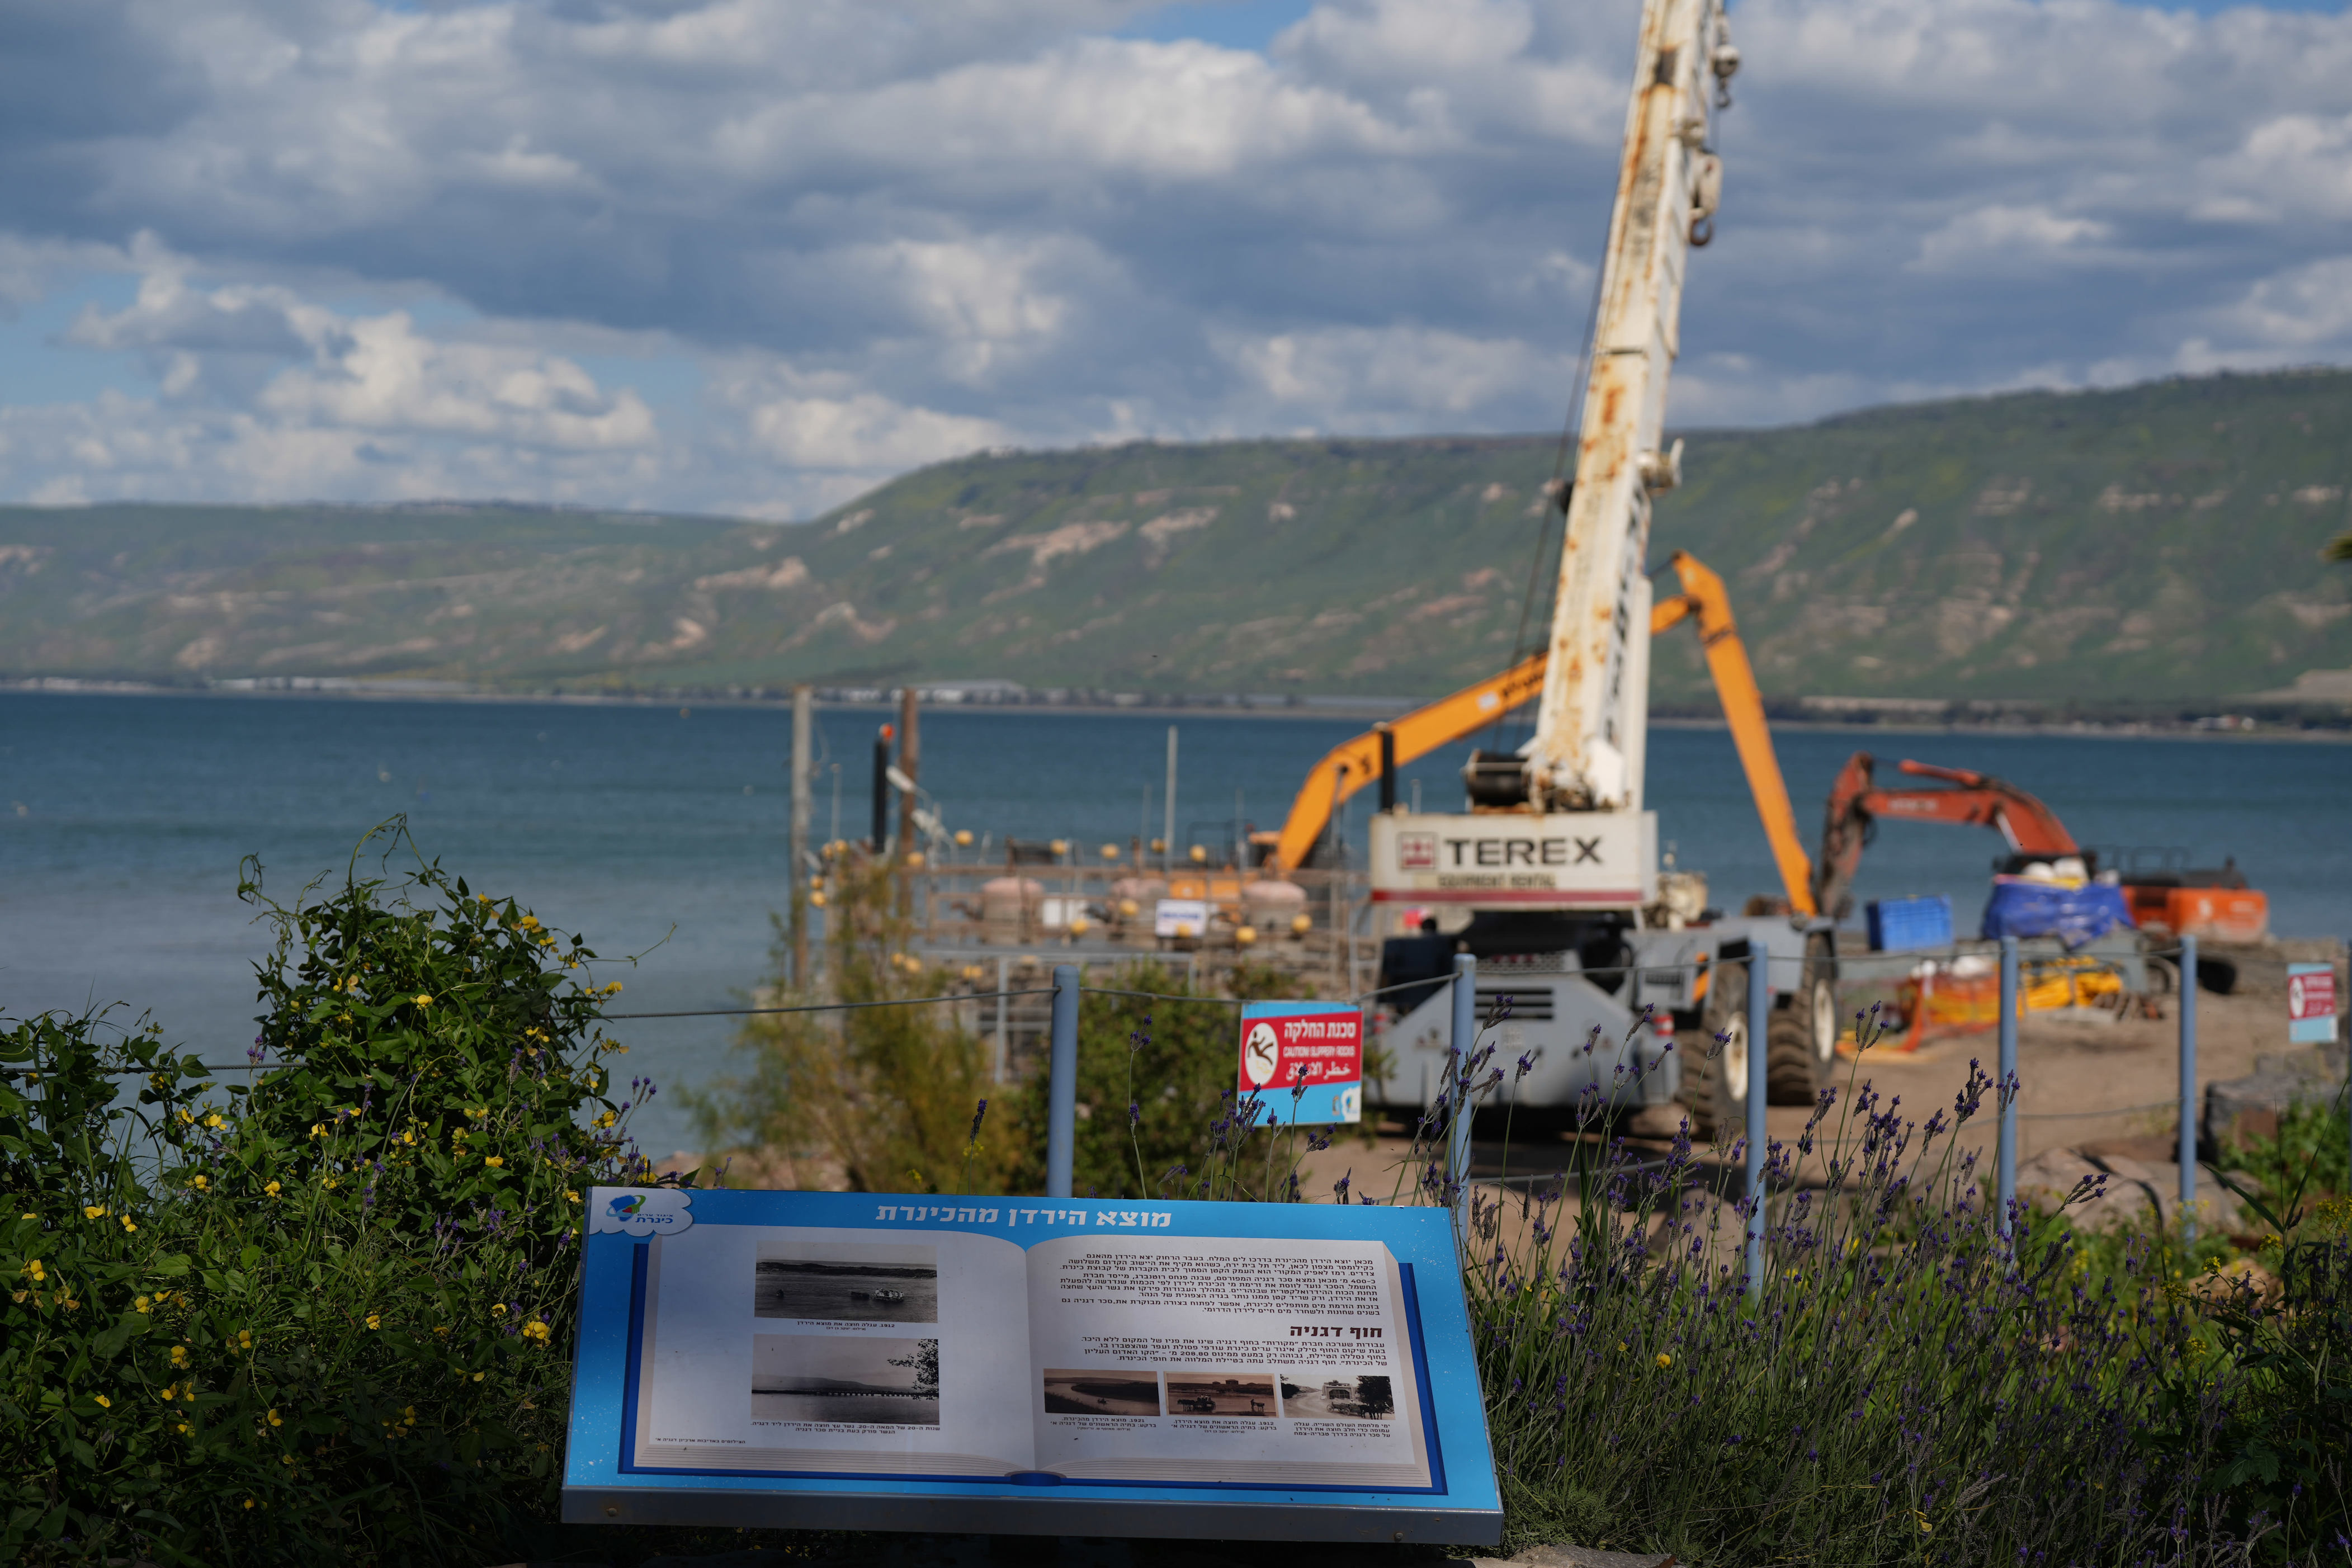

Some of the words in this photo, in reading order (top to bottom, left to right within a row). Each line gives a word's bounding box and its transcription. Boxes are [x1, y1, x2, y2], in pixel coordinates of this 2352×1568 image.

[1444, 837, 1602, 865] TEREX
[1284, 1019, 1325, 1043] החלקה
[1327, 1022, 1356, 1038] סכנת
[1323, 1061, 1351, 1080] خطر
[876, 1206, 999, 1223] מהכינרת
[1009, 1208, 1087, 1227] הירדן
[1096, 1211, 1172, 1227] מוצא
[1290, 1326, 1343, 1337] דגניה
[1349, 1327, 1382, 1339] חוף
